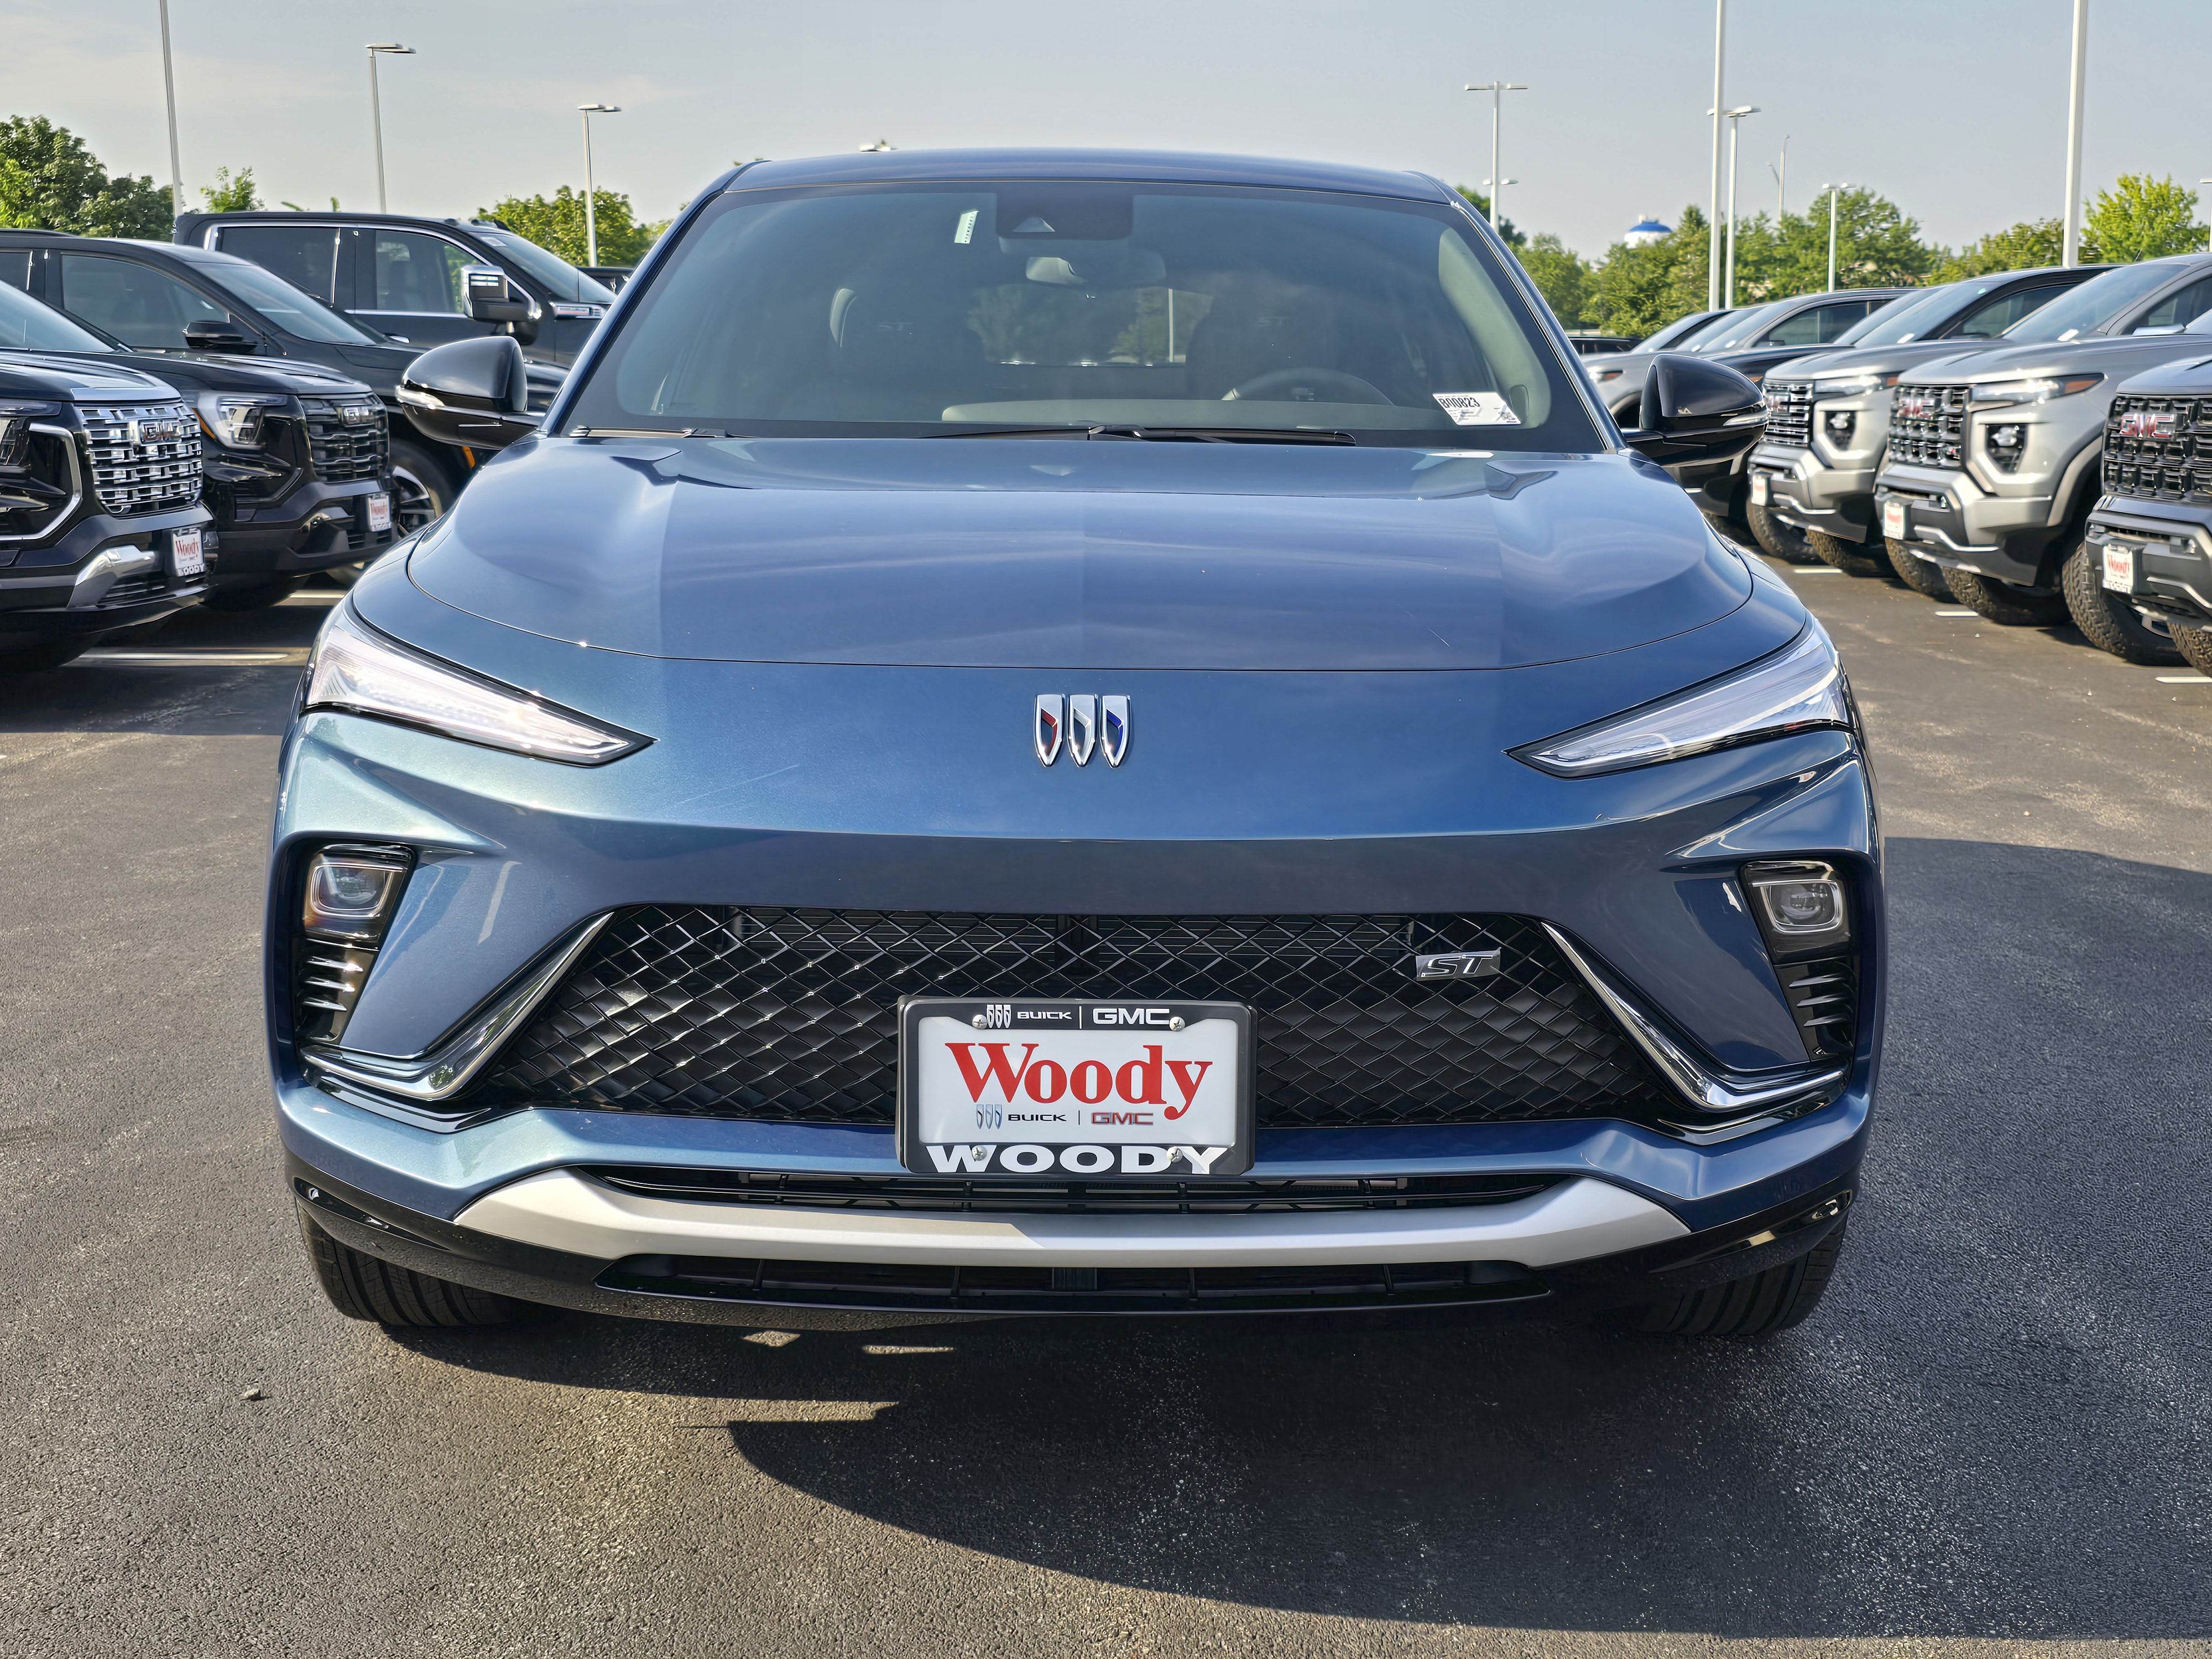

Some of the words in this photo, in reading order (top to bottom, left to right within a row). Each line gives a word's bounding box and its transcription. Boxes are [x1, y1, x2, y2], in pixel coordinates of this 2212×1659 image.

[175, 538, 200, 558] Woody
[1420, 954, 1494, 978] ST
[1017, 1010, 1072, 1020] BUICK
[1092, 1008, 1171, 1025] GMC
[944, 1042, 1213, 1120] Woody
[1008, 1113, 1067, 1122] BUICK
[1091, 1112, 1154, 1126] GMC
[925, 1144, 1228, 1175] WOODY
